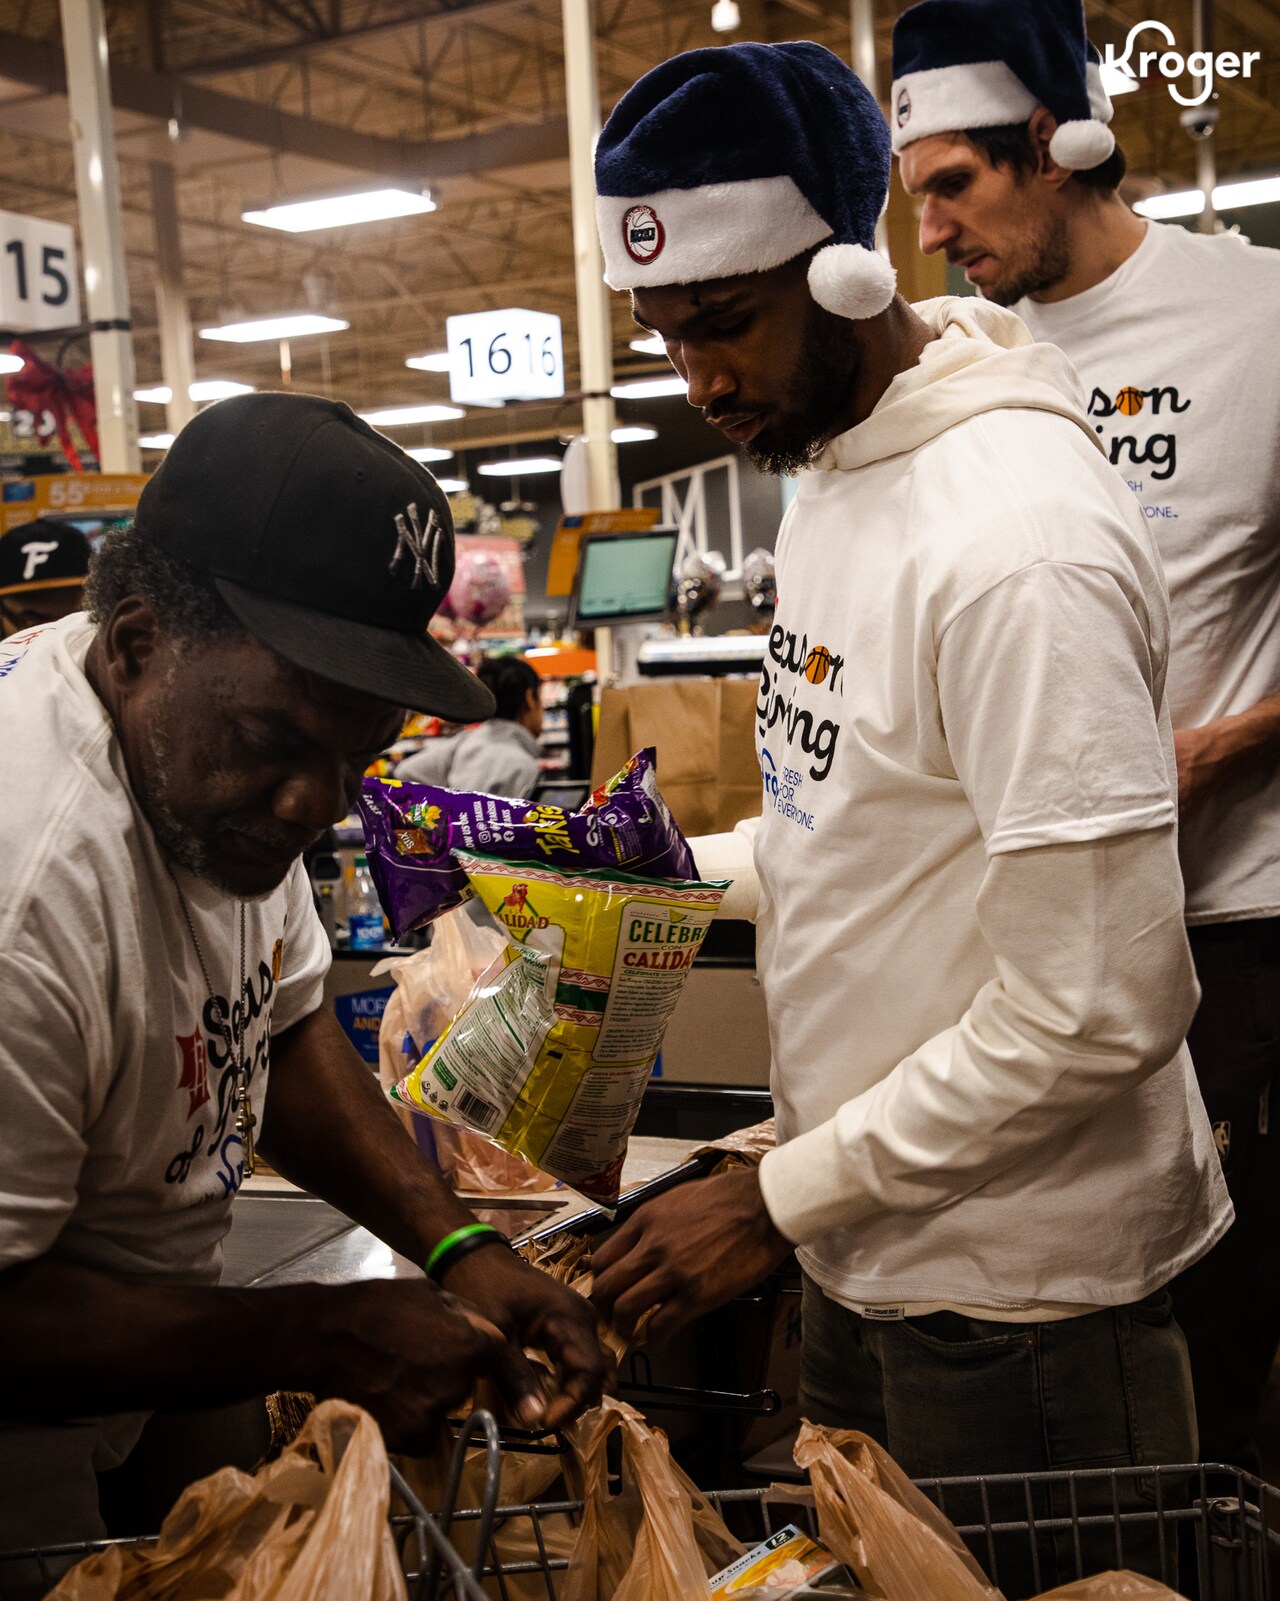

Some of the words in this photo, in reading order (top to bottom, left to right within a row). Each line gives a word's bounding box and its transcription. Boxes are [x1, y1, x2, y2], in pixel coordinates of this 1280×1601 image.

[6, 239, 70, 306] 15
[460, 332, 512, 378] 16
[525, 333, 556, 376] 16
[21, 540, 59, 580] F
[493, 911, 551, 929] ALIDAD
[351, 997, 388, 1015] MOR
[711, 1573, 725, 1585] up
